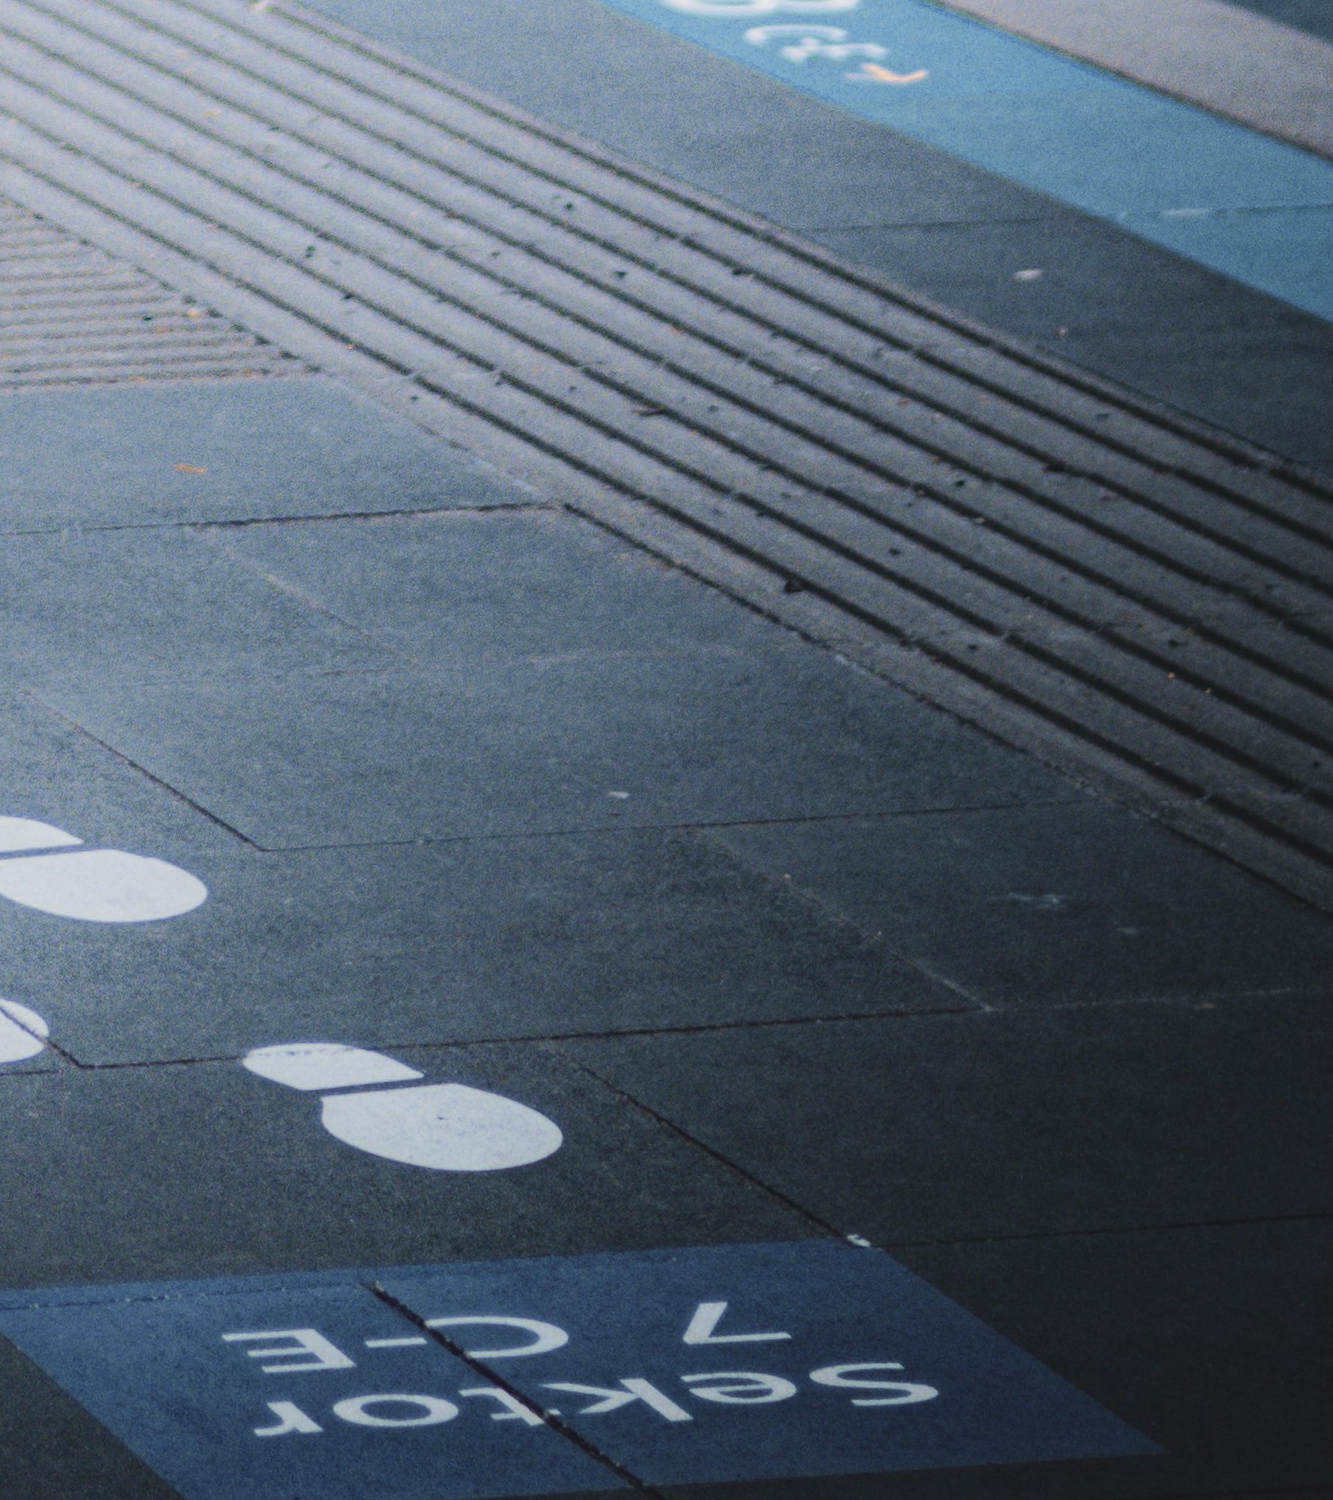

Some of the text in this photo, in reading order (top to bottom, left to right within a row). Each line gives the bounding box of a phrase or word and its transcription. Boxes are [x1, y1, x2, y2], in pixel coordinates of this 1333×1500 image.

[221, 1300, 792, 1374] 7 C-E
[253, 1362, 939, 1437] Sektor
